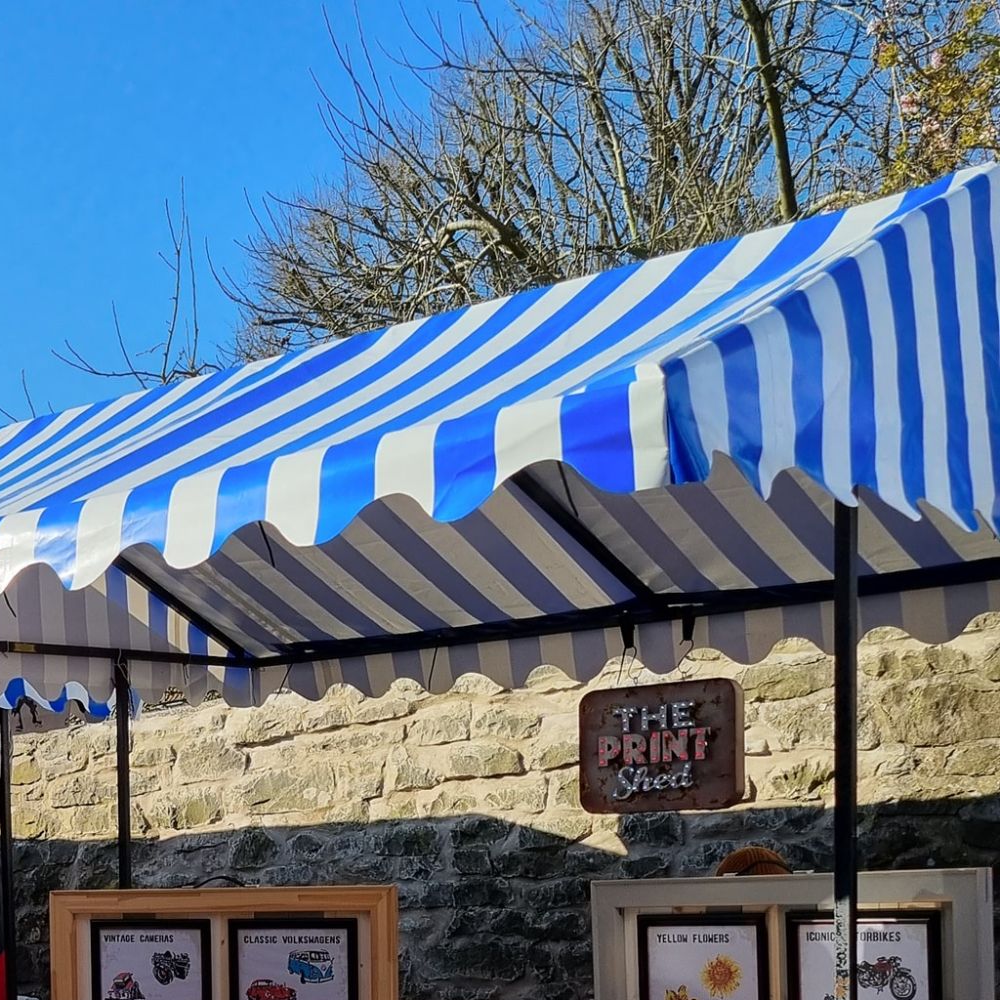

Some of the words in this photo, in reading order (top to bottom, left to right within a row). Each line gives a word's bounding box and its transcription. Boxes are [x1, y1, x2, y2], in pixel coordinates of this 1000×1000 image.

[614, 701, 694, 732] THE
[598, 727, 710, 767] PRINT
[613, 762, 693, 800] Shed
[104, 934, 135, 943] VINTAGE
[140, 934, 174, 943] CAMERAS
[243, 935, 278, 944] CLASSIC
[282, 935, 341, 944] VOLKSWAGENS
[656, 933, 688, 944] YELLOW
[692, 933, 730, 944] FLOWERS
[806, 931, 836, 942] ICONIC
